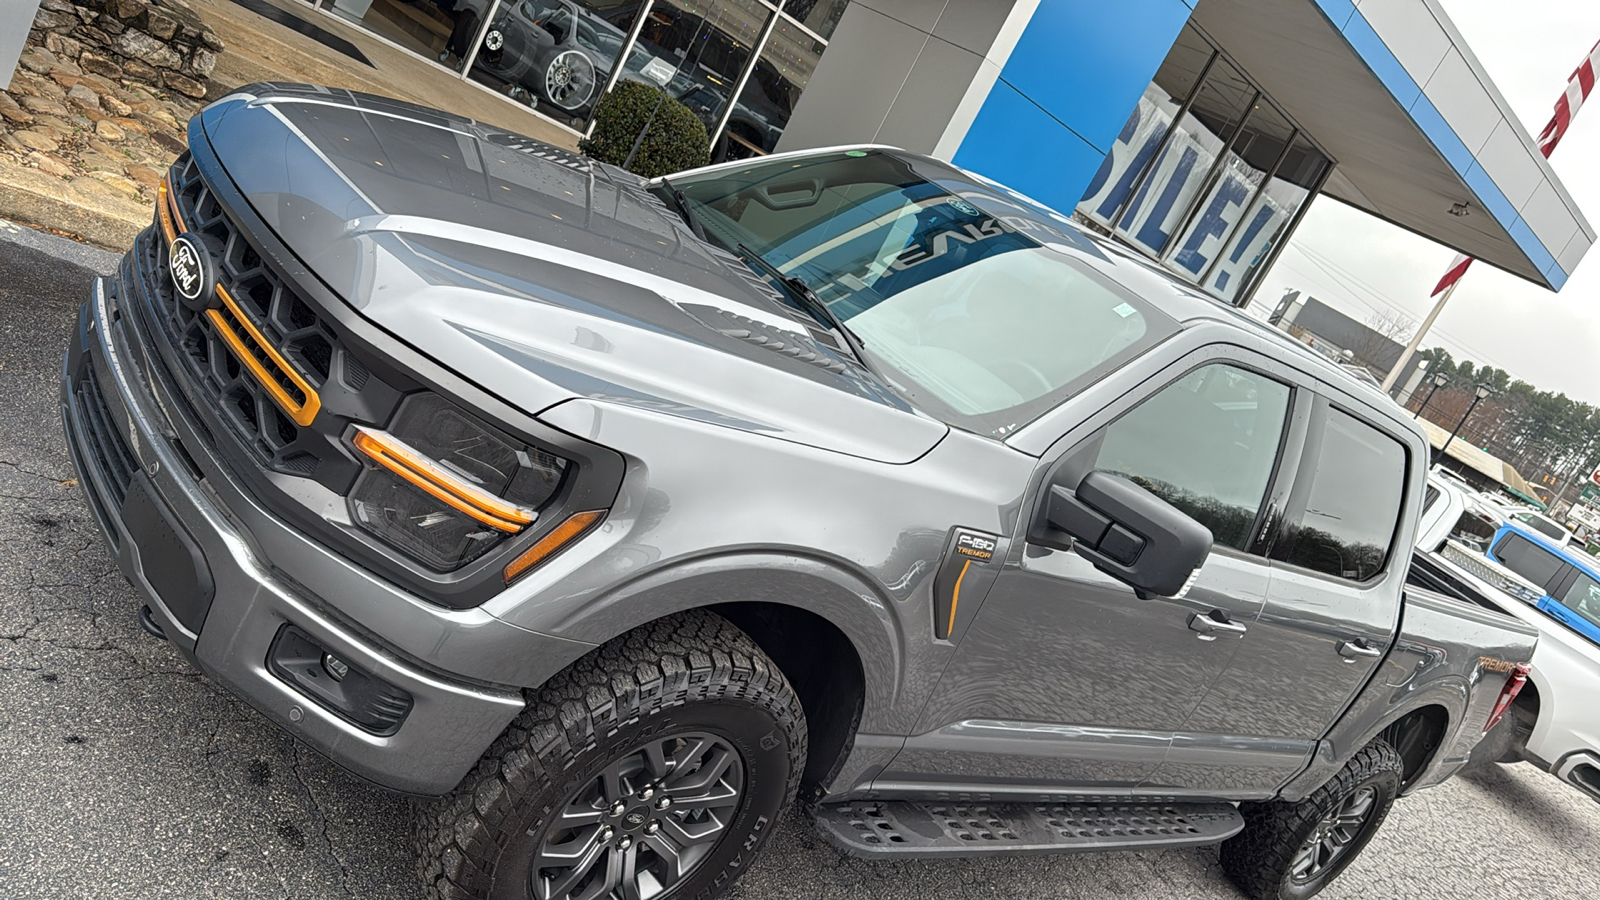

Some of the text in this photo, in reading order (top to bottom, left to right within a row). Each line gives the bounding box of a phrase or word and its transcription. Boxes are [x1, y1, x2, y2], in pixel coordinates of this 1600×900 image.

[171, 244, 197, 292] Ford
[959, 535, 995, 551] F-150
[957, 546, 992, 559] TREMOR
[1478, 656, 1516, 673] TREMOR
